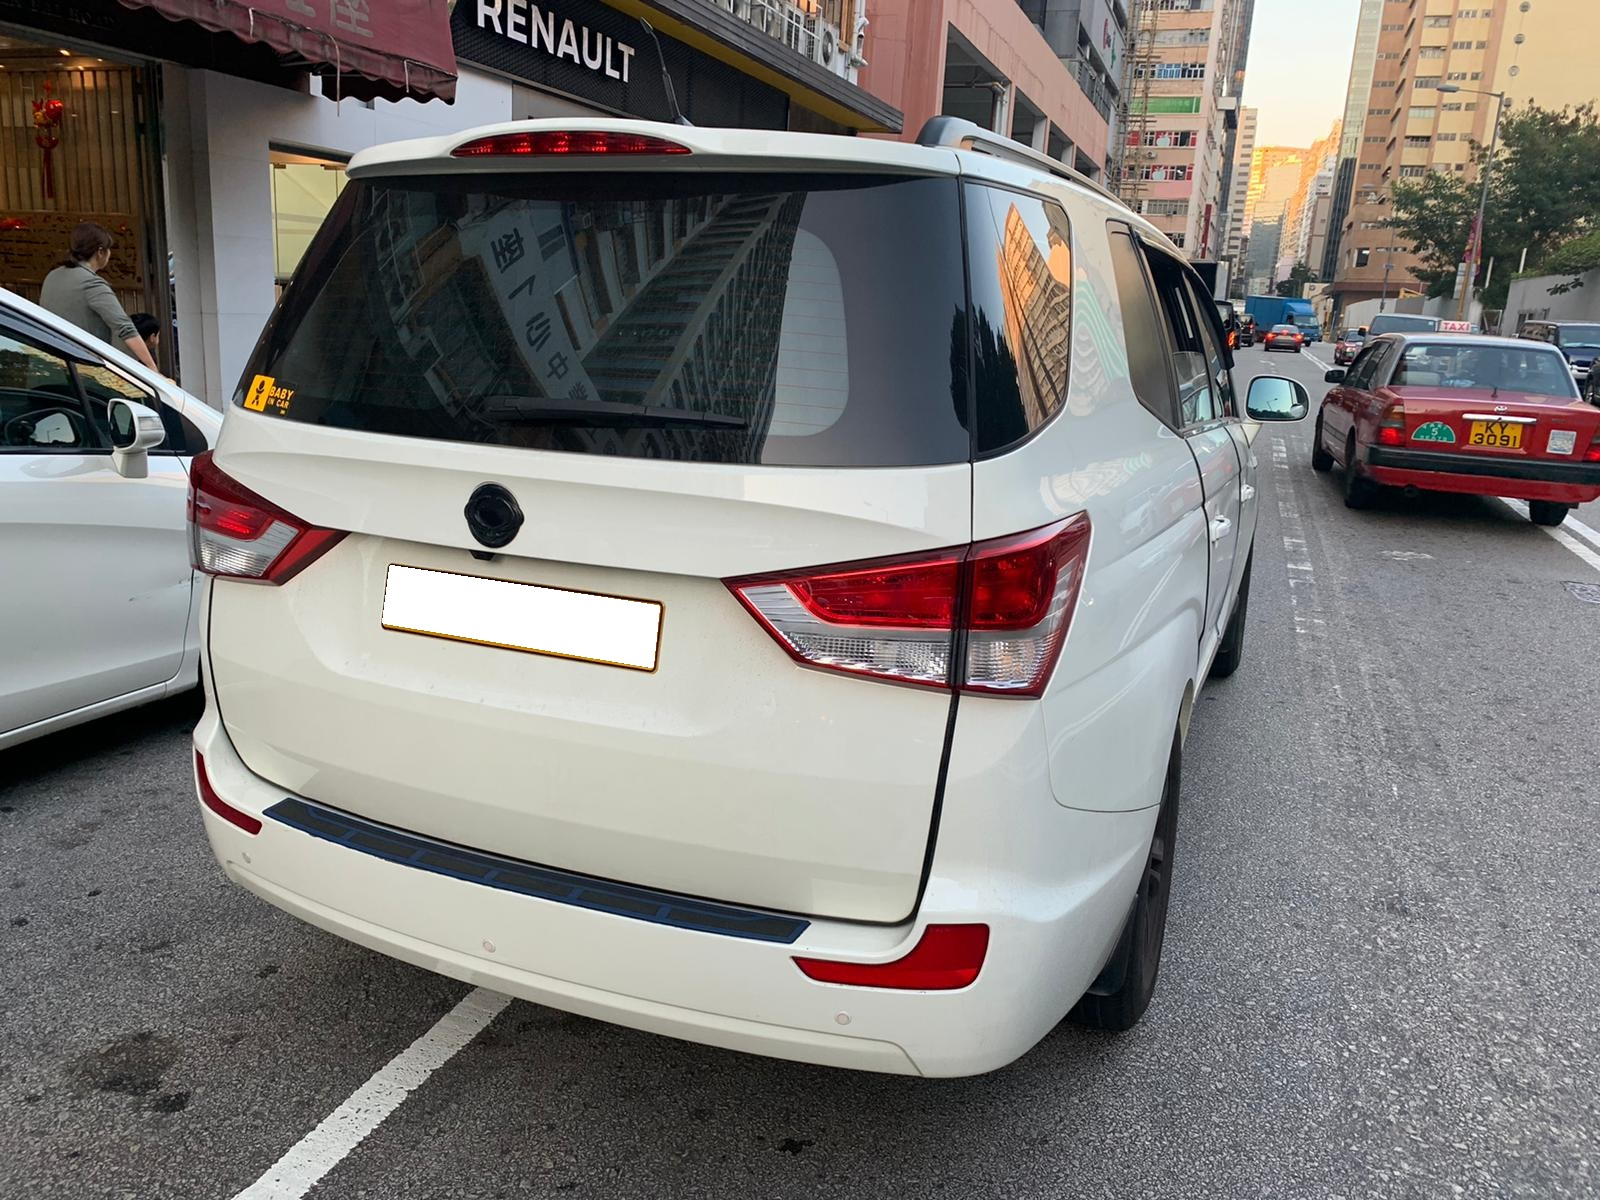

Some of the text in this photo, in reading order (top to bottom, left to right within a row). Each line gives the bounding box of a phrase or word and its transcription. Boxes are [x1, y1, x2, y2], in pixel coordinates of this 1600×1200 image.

[477, 0, 635, 83] RENAULT
[1443, 322, 1471, 331] TAXI
[269, 386, 295, 401] BABY
[276, 399, 290, 409] CAR
[1485, 419, 1509, 434] KY
[1473, 433, 1517, 447] 3091
